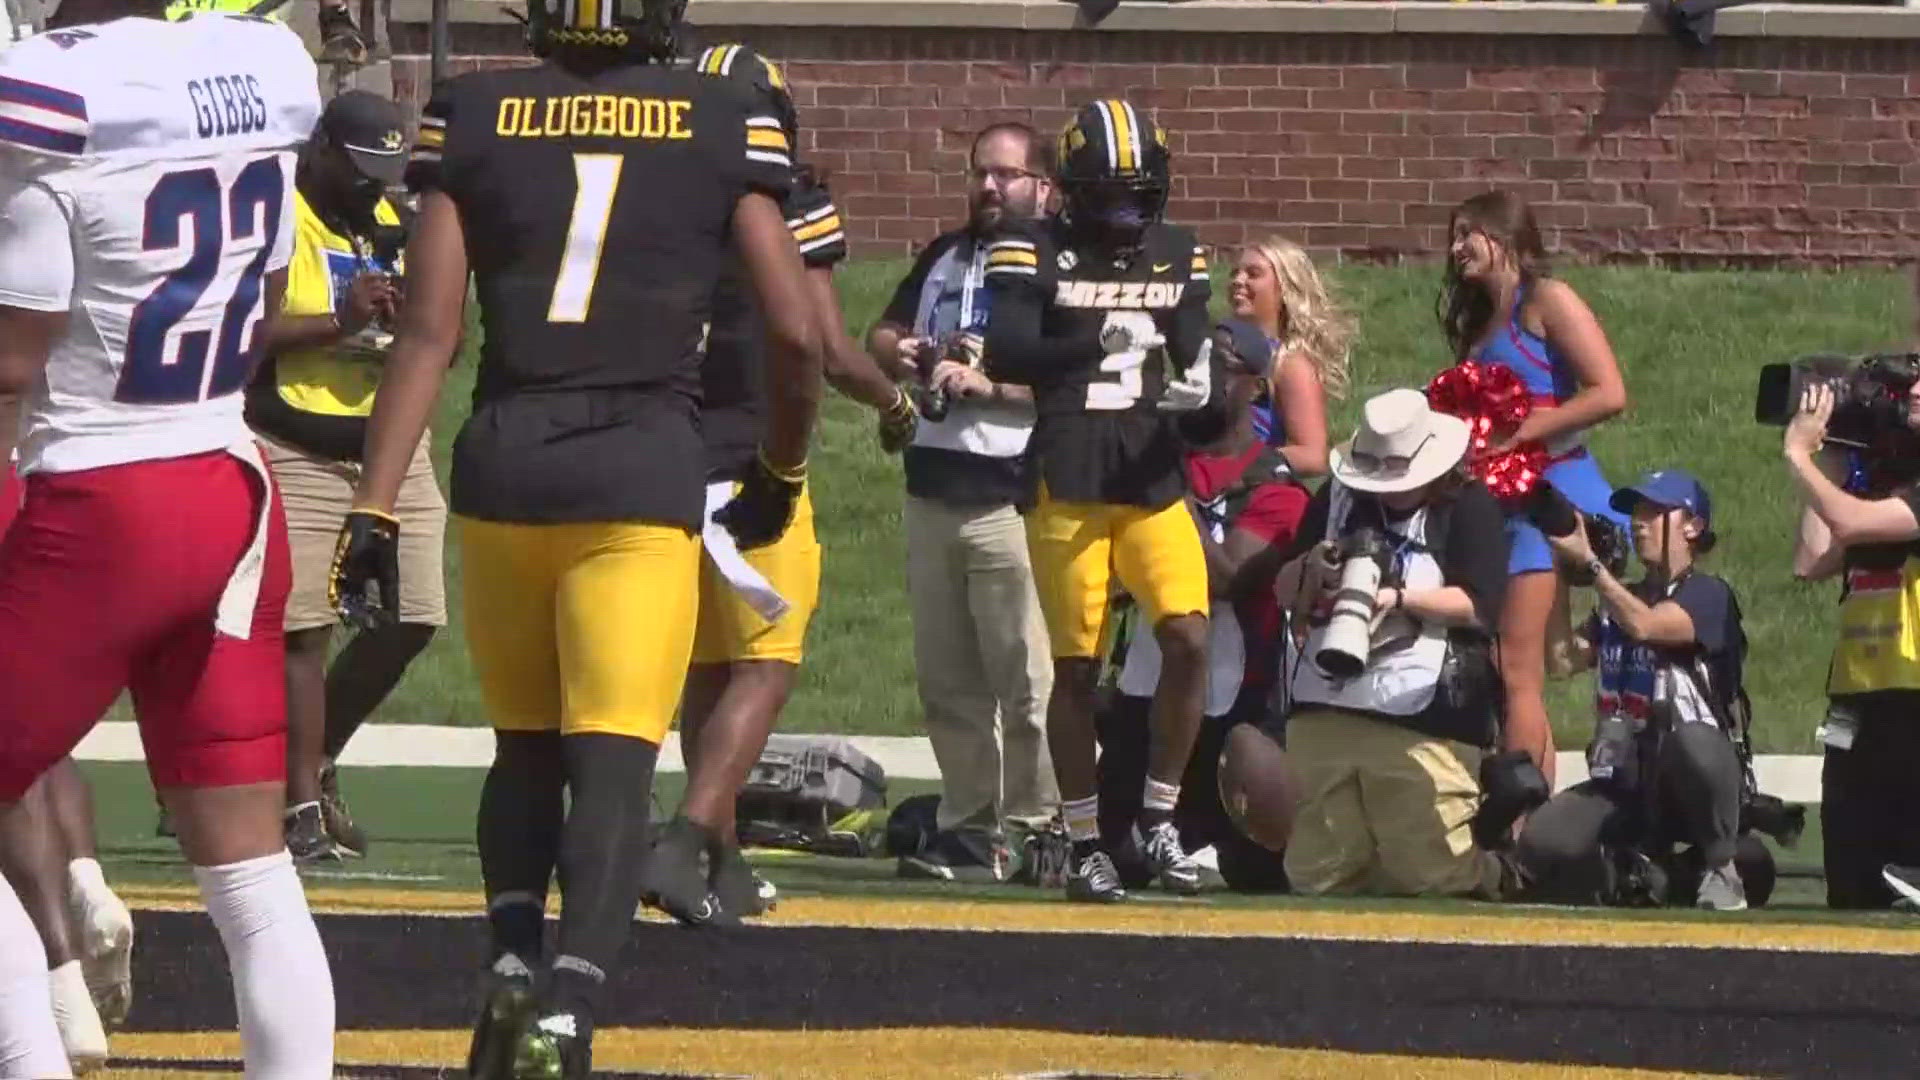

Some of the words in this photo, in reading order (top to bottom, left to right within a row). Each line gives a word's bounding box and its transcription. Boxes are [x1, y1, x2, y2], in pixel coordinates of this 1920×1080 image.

[187, 74, 267, 139] GIBBS
[496, 95, 693, 139] OLUGBODE
[547, 153, 624, 322] 1
[113, 153, 284, 405] 22
[1054, 280, 1185, 308] MIZZOU
